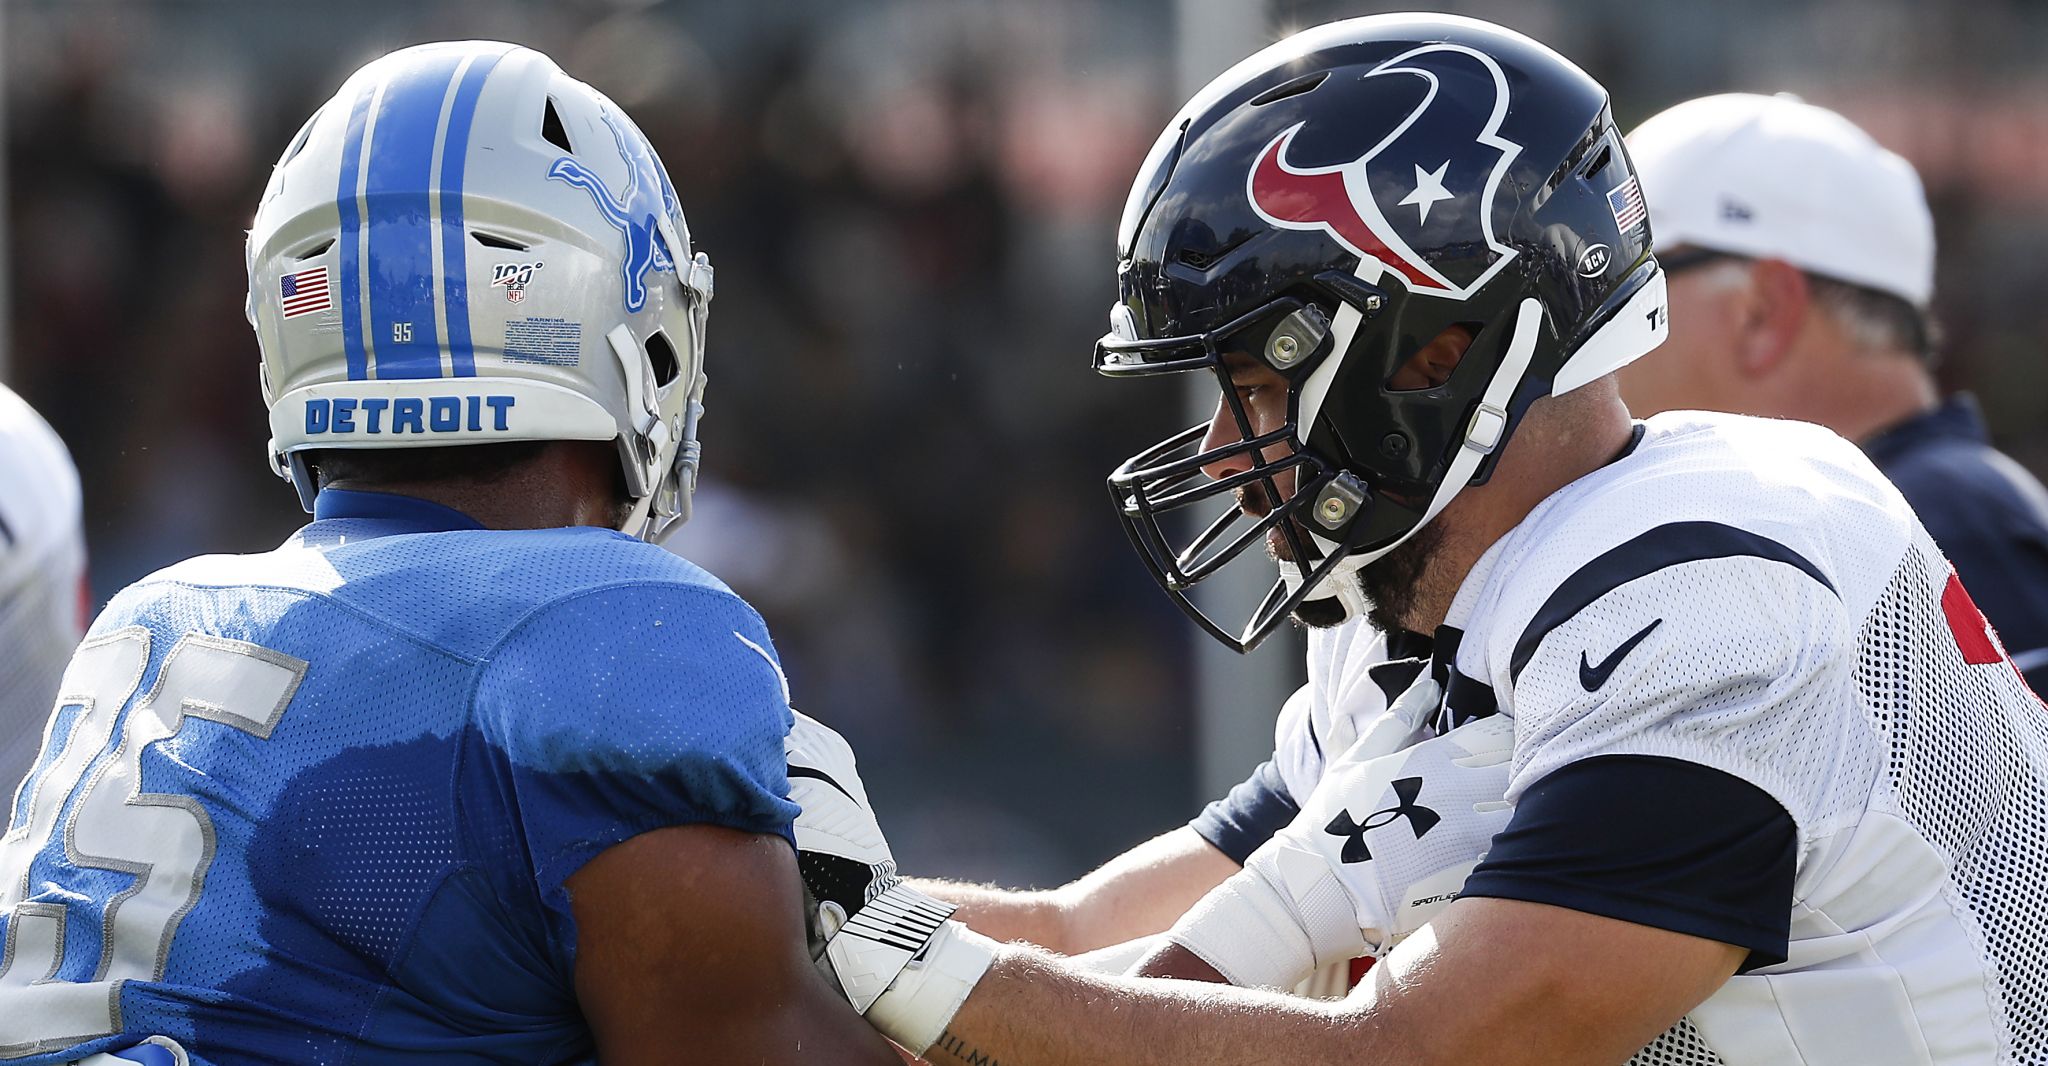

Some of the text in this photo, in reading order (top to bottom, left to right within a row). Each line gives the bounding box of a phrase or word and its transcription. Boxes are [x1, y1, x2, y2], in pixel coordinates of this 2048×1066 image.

[508, 290, 523, 301] NFL
[393, 322, 412, 342] 95
[305, 396, 515, 434] DETROIT
[1411, 891, 1461, 907] SPOTLIG
